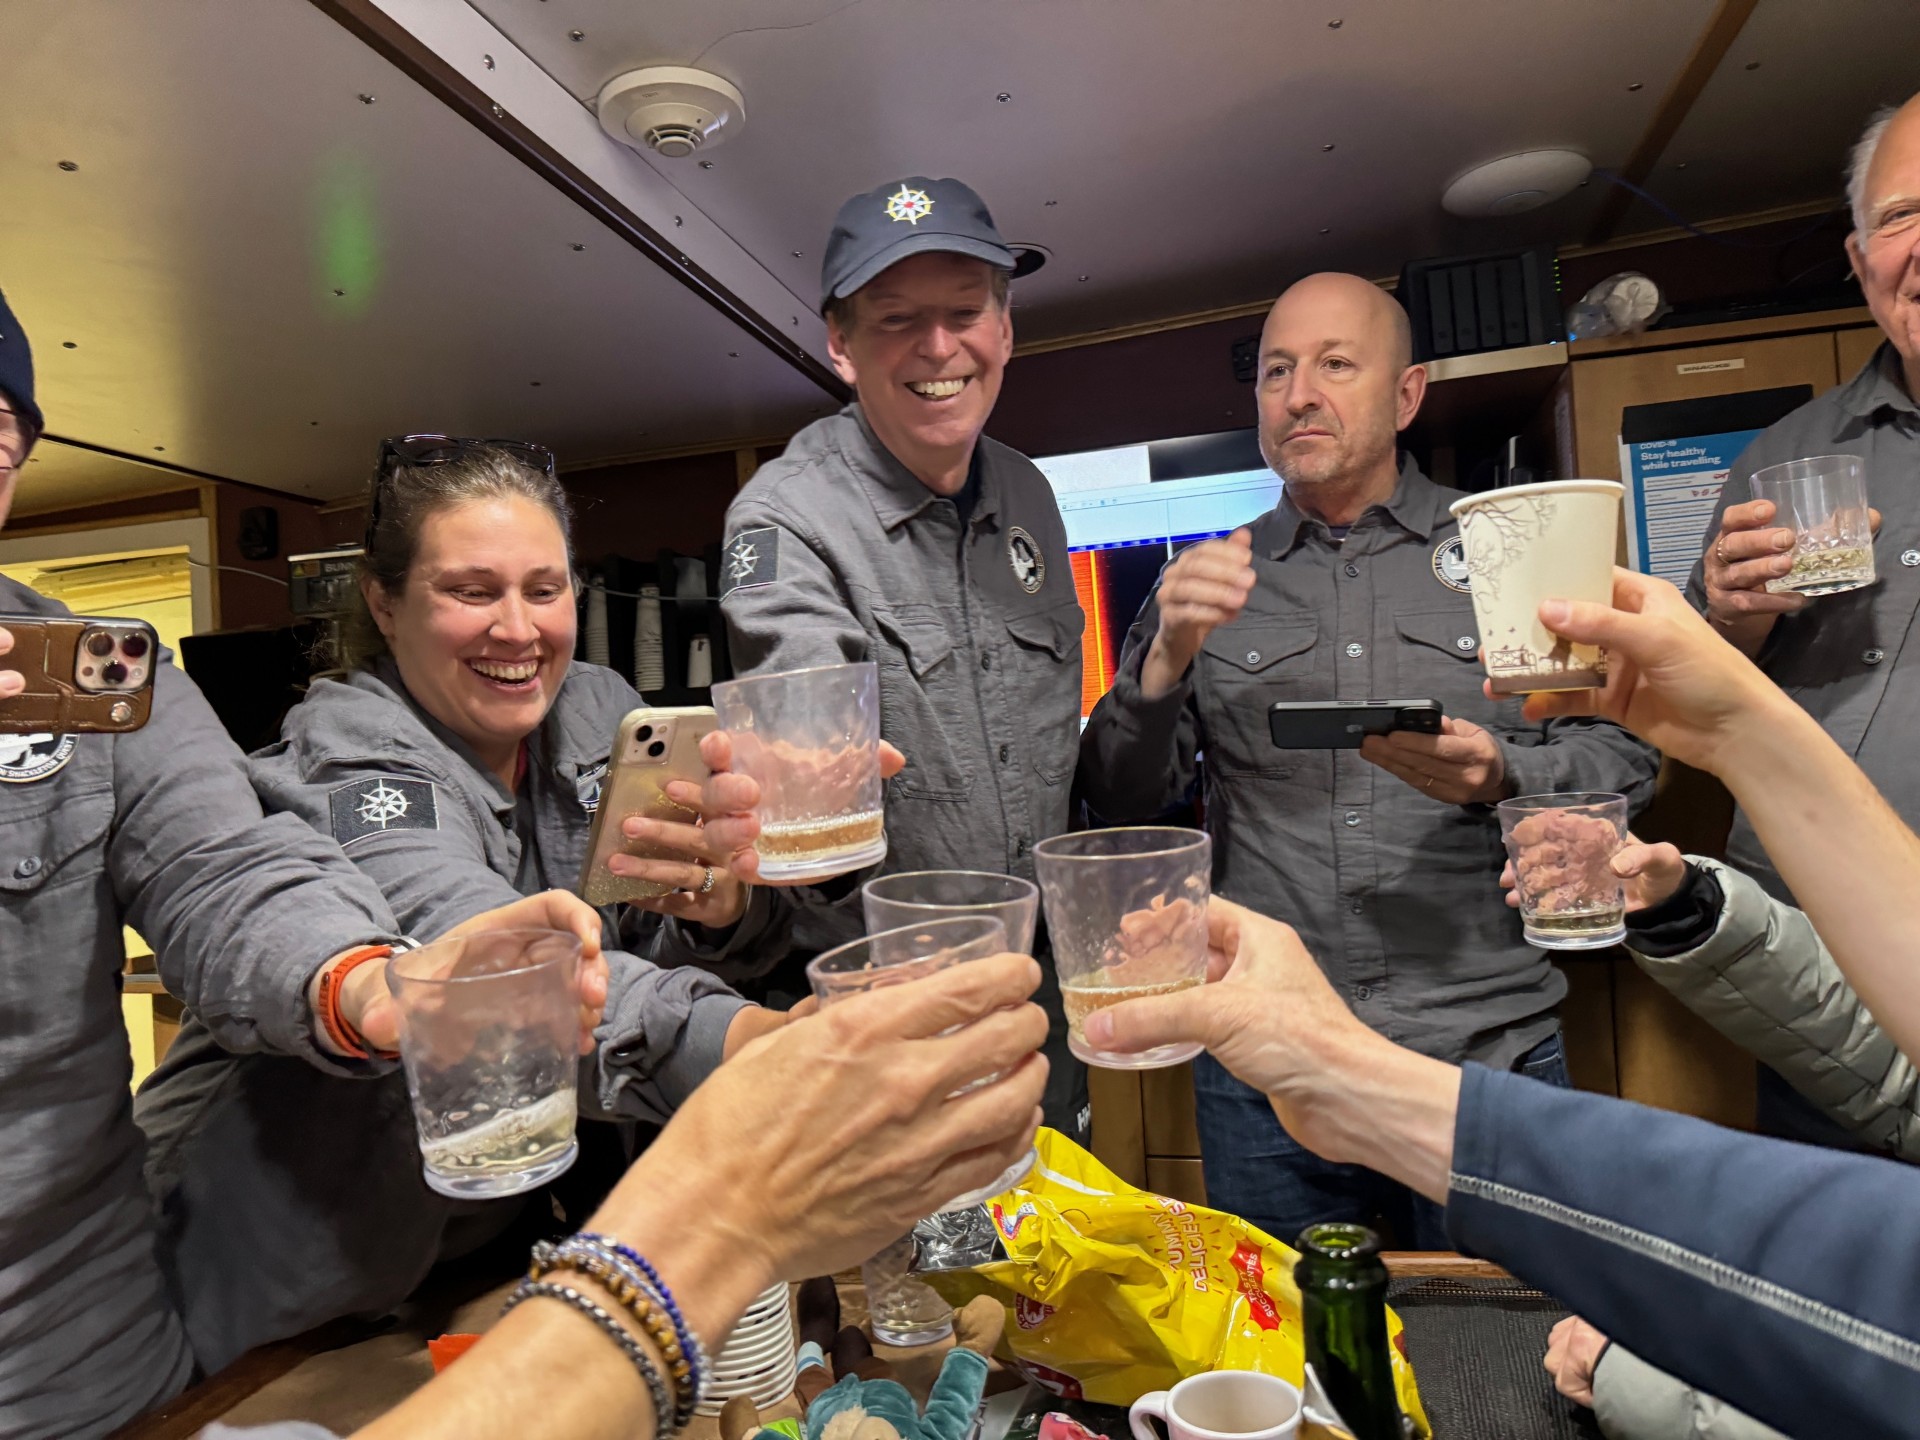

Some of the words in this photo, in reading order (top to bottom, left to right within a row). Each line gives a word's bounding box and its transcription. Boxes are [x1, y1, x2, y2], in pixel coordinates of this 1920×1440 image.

[1640, 440, 1678, 450] COVID-19
[1641, 451, 1665, 461] Stay
[1666, 447, 1707, 458] healthy
[1641, 460, 1670, 471] while
[1671, 456, 1722, 468] travelling
[1238, 1269, 1258, 1303] TASTY
[1245, 1253, 1275, 1318] SUCCULENTES
